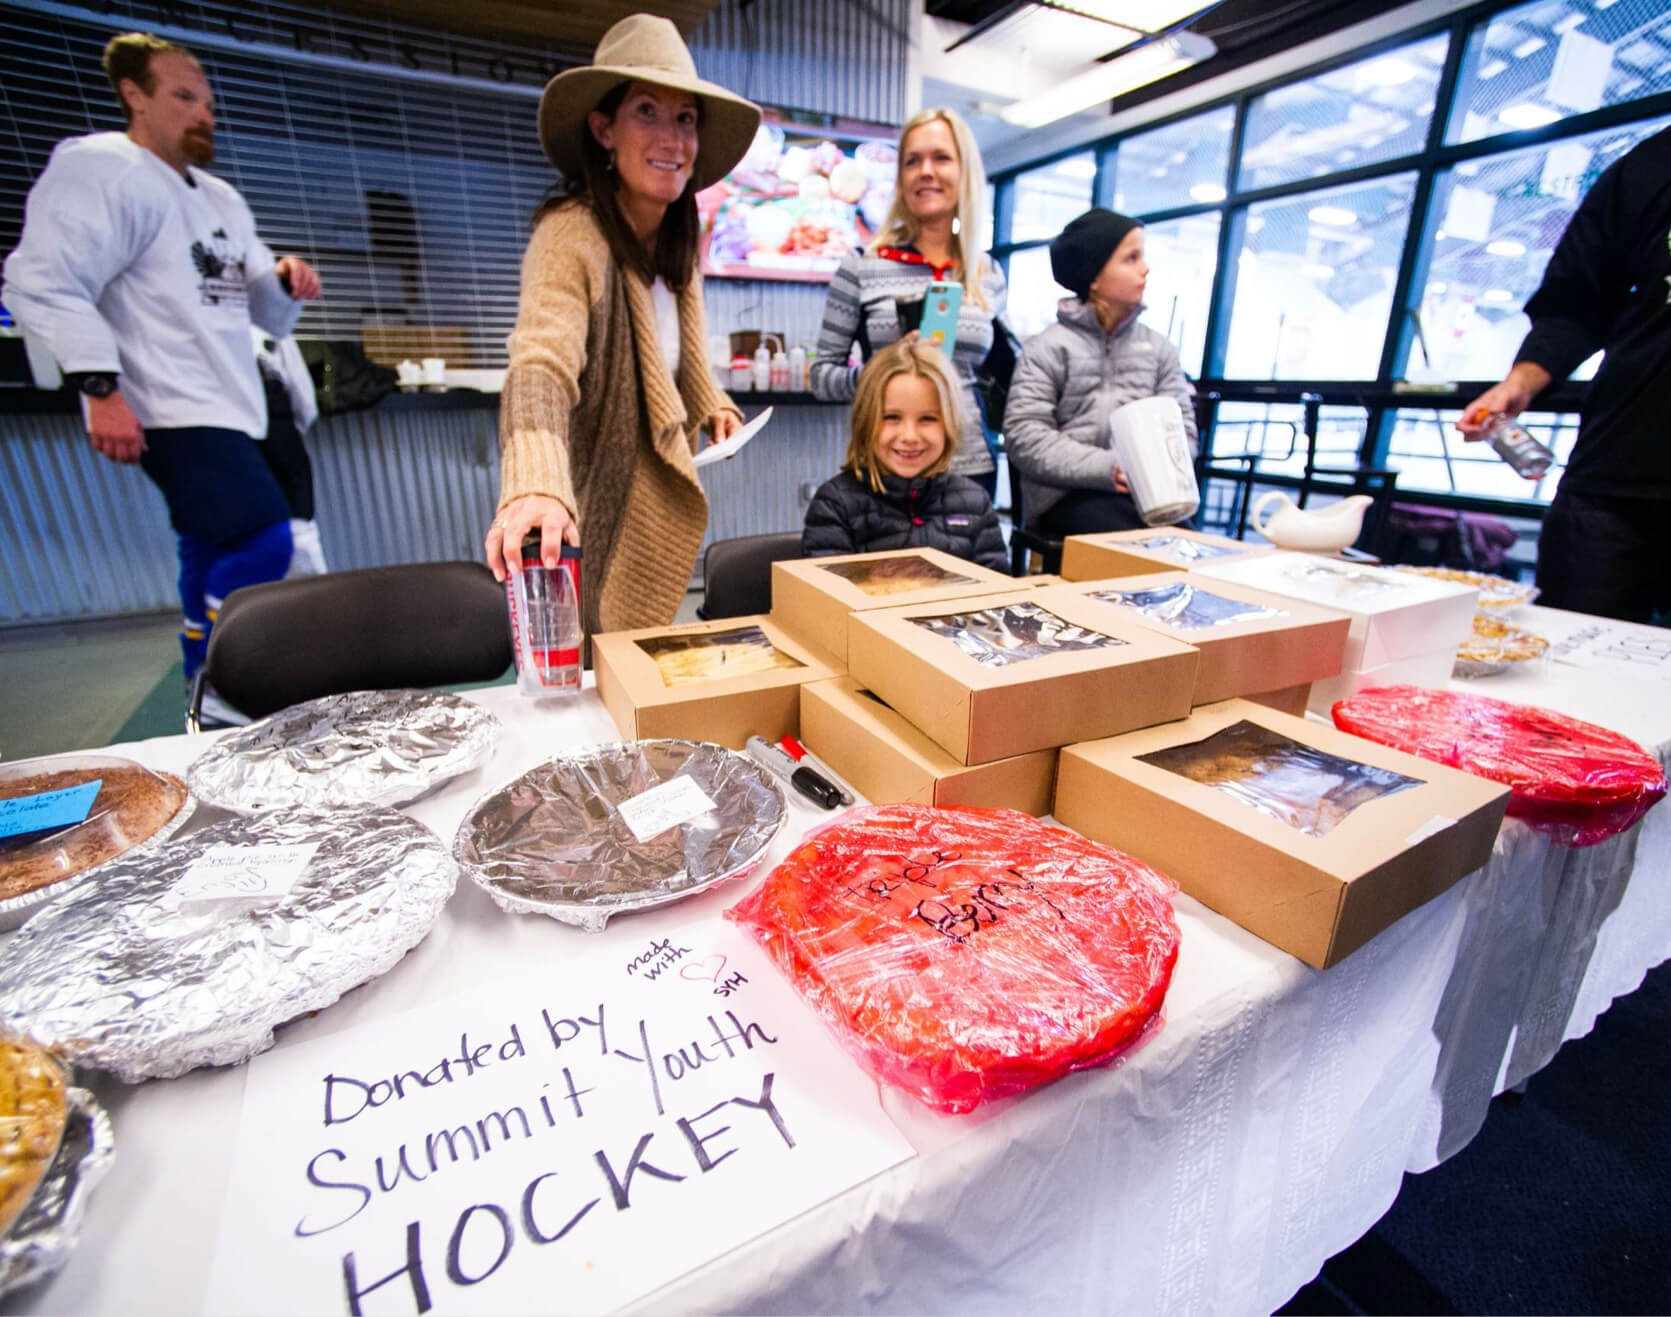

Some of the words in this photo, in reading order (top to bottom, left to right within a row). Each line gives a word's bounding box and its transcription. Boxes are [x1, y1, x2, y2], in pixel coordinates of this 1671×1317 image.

[626, 938, 671, 976] made
[643, 947, 693, 981] with
[712, 970, 750, 998] SYH
[322, 1023, 526, 1128] Donated
[541, 1003, 608, 1055] by
[293, 1067, 598, 1238] Summit
[613, 1010, 779, 1116] Youth
[341, 1072, 796, 1317] HOCKEY
